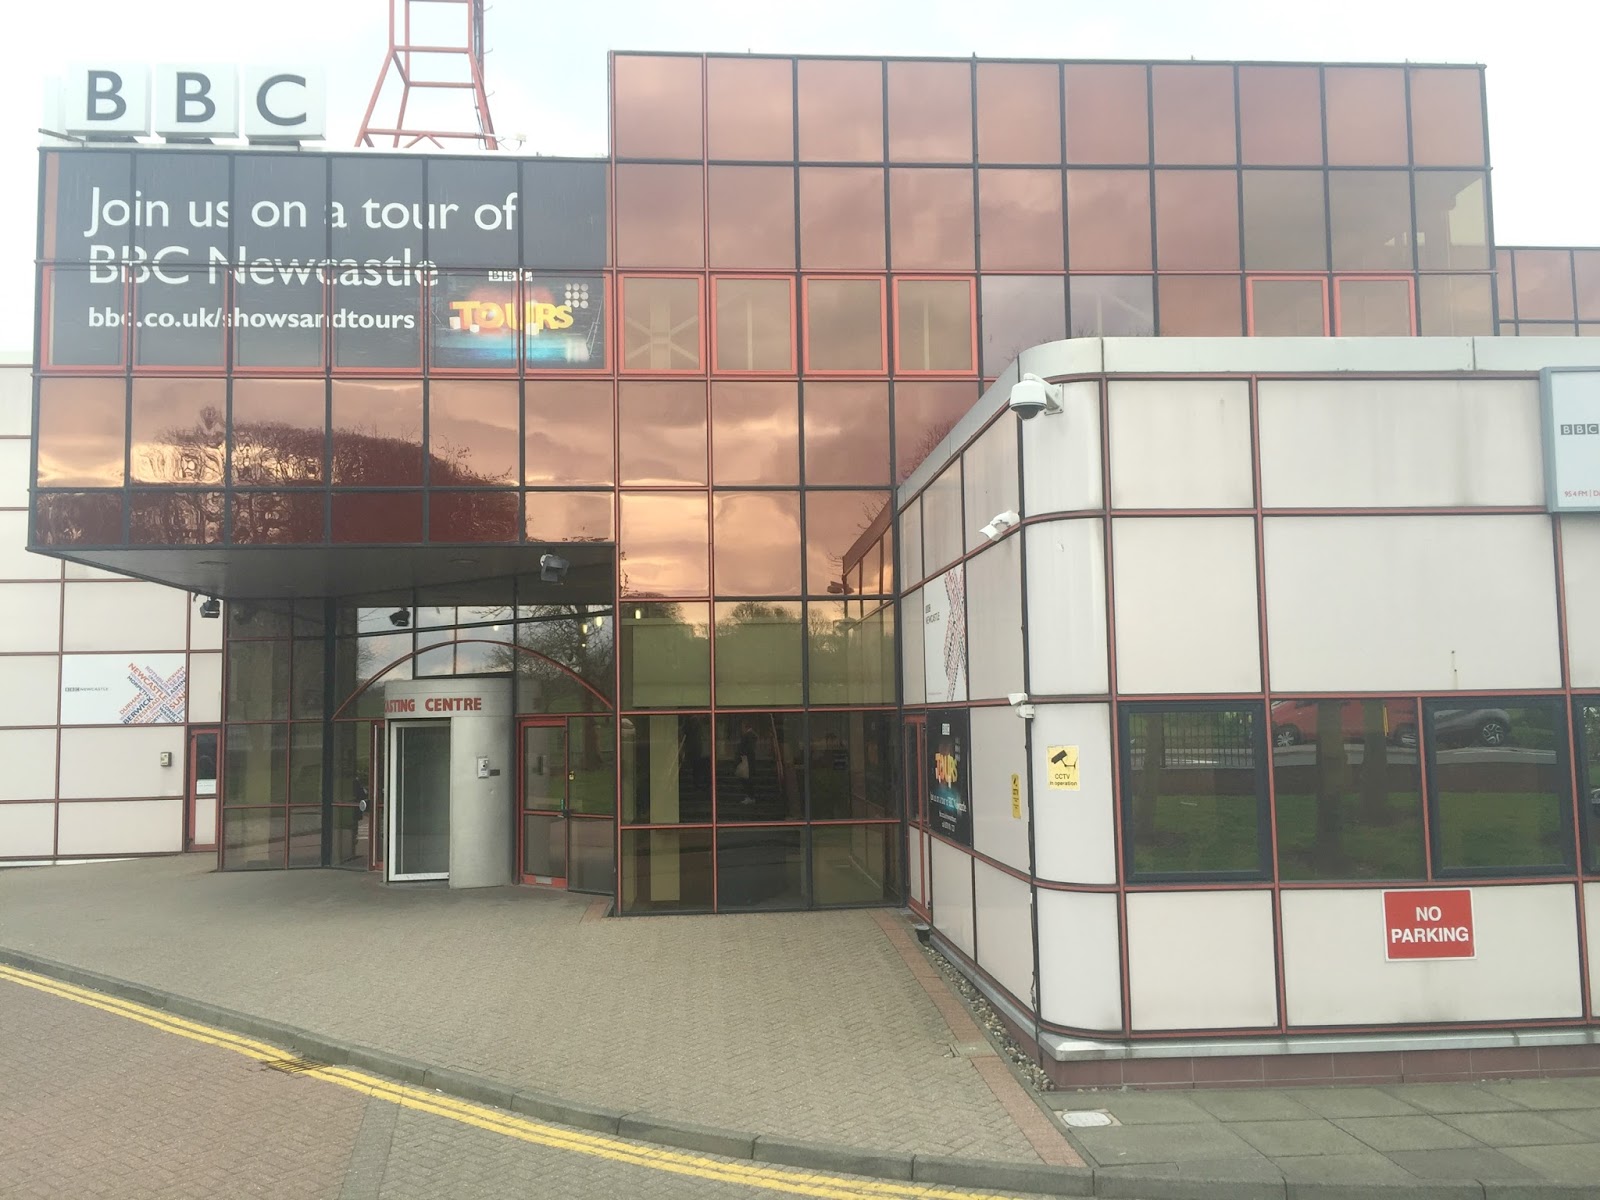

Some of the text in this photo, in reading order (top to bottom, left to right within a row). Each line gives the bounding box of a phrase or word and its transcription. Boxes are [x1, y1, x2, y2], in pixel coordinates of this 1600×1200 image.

[86, 69, 307, 126] BBC
[83, 186, 518, 238] Join us on a tour of
[89, 244, 439, 288] BBC Newcastle
[449, 300, 574, 332] TOURS
[1560, 423, 1600, 436] BBC
[128, 662, 168, 702] NEWCASTLE
[424, 697, 482, 712] CENTRE
[1415, 906, 1442, 922] NO
[1391, 926, 1469, 943] PARKING
